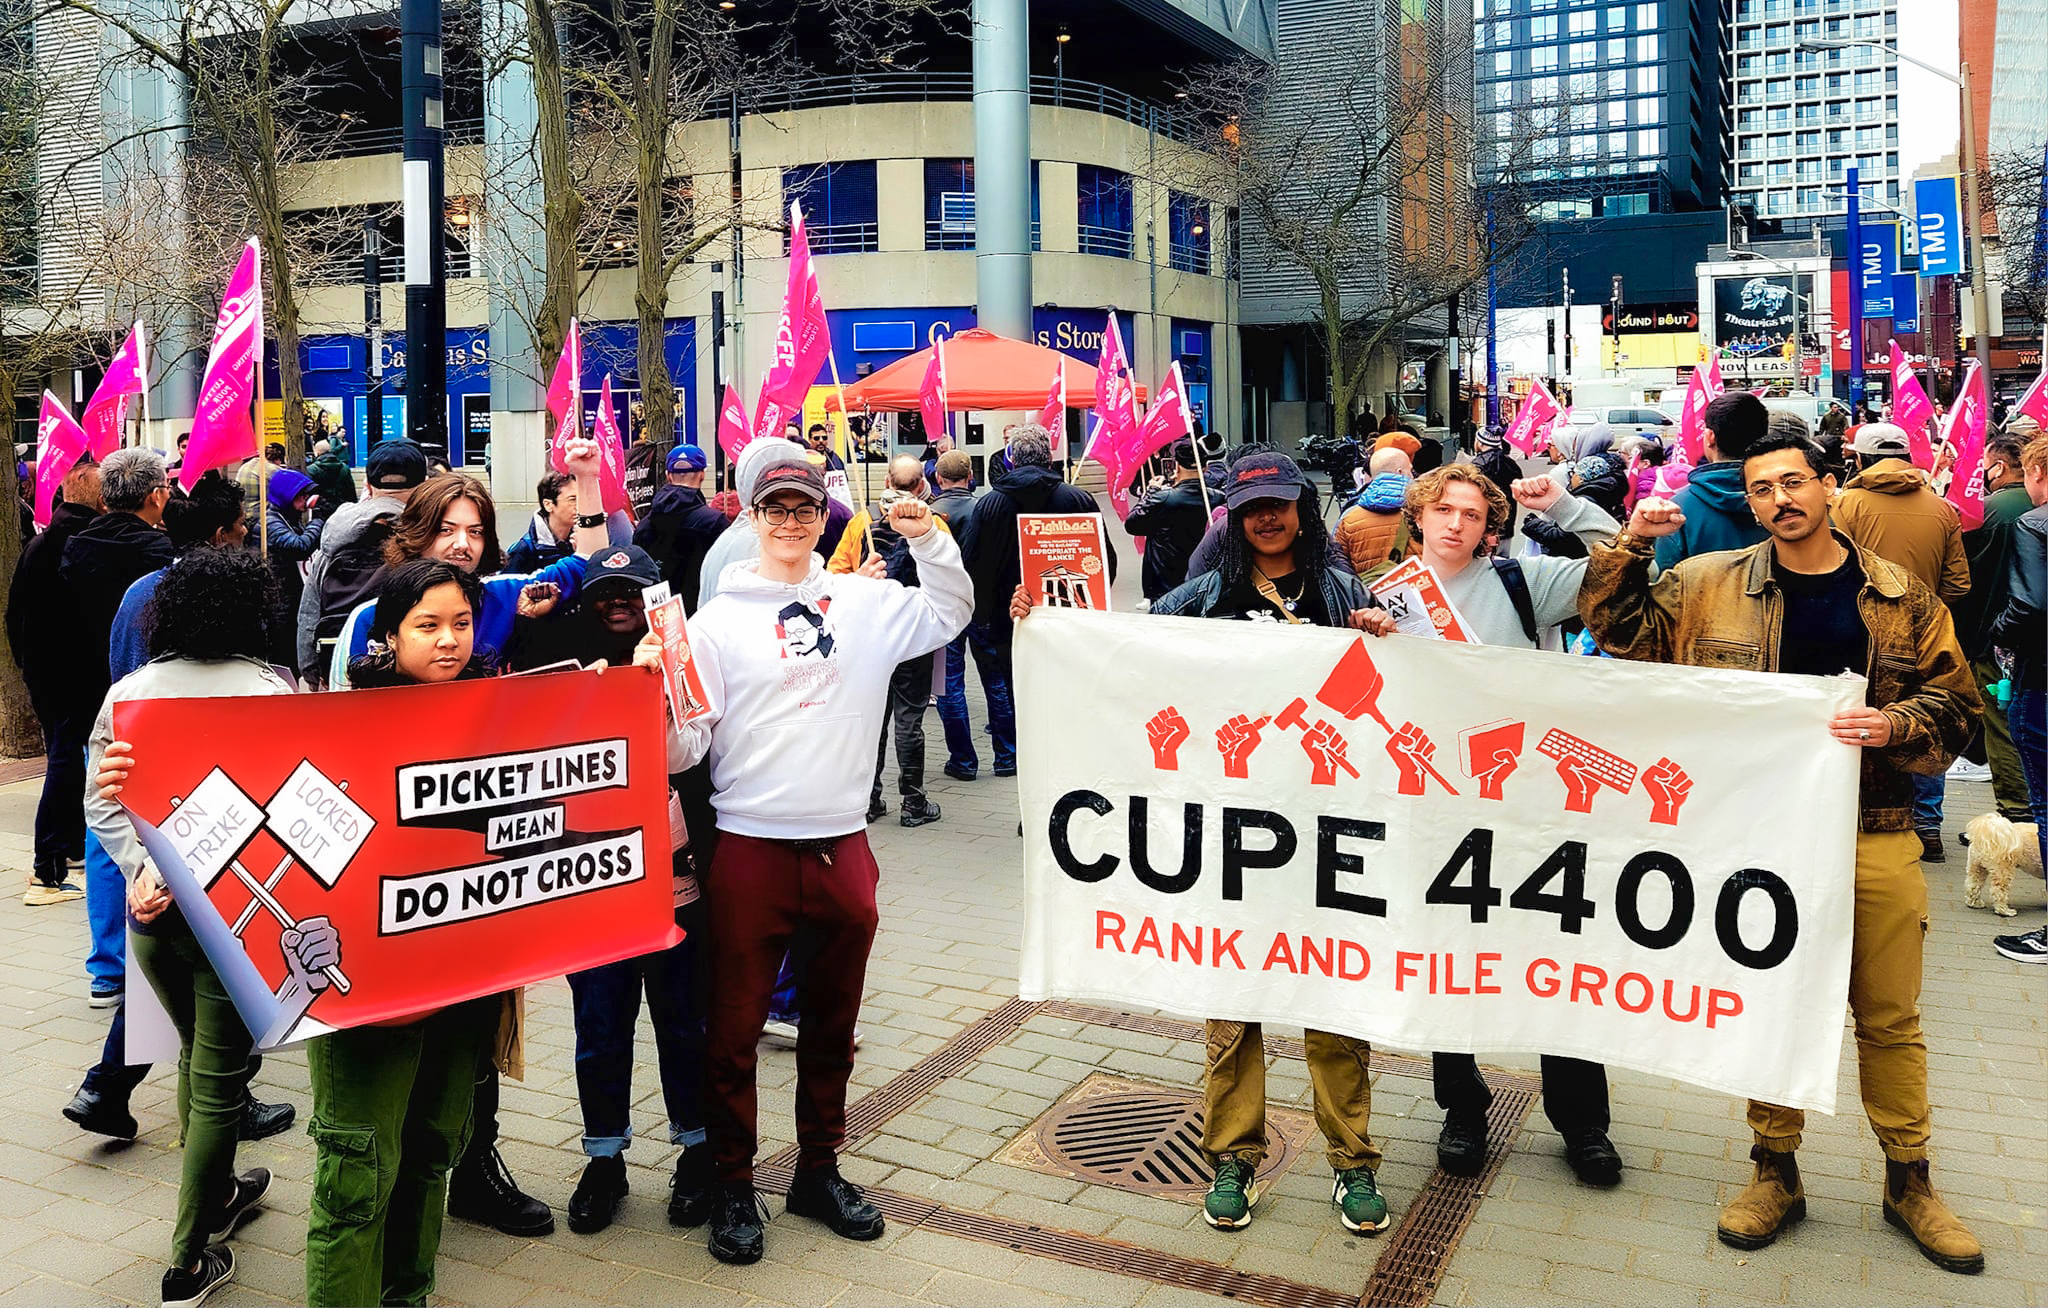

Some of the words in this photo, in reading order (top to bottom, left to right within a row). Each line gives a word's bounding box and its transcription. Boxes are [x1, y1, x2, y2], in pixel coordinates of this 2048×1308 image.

[1863, 243, 1882, 289] TMU
[1920, 213, 1947, 271] TMU
[1029, 519, 1096, 536] Fightback
[1077, 546, 1092, 554] THE
[413, 761, 535, 809] PICKET
[541, 750, 618, 790] LINES
[173, 802, 210, 841] ON
[294, 775, 361, 843] LOCKED
[495, 810, 557, 844] MEAN
[288, 816, 332, 862] OUT
[395, 883, 450, 923] DO
[461, 867, 528, 909] NOT
[536, 842, 632, 890] CROSS
[1049, 790, 1387, 918] CUPE
[1425, 828, 1799, 970] 4400
[1096, 910, 1246, 970] RANK
[1263, 932, 1371, 981] AND
[1395, 950, 1502, 995] FILE
[1525, 957, 1744, 1029] GROUP
